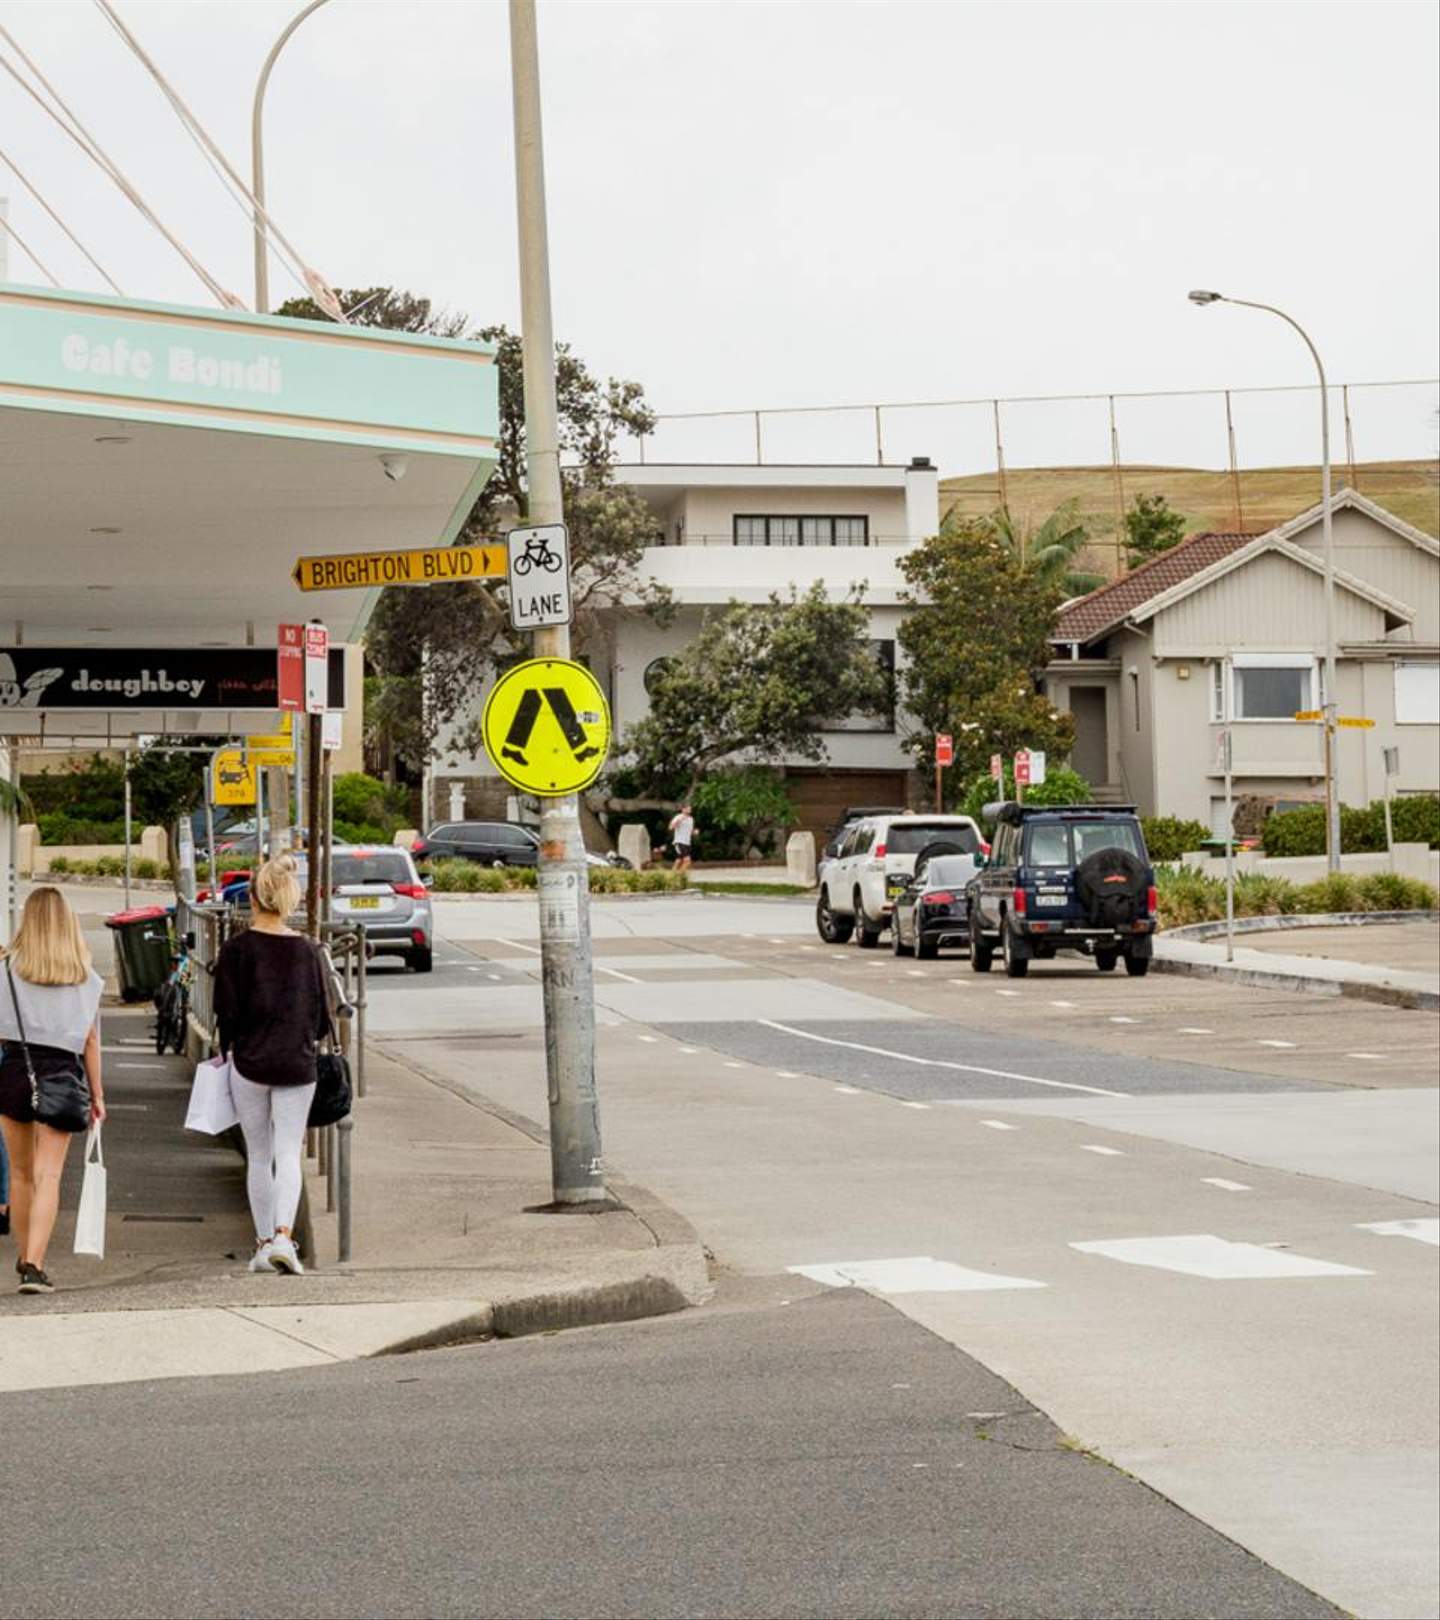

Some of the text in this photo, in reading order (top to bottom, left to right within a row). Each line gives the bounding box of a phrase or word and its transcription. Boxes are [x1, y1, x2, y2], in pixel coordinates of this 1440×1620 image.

[62, 333, 283, 395] Cafe Bondi
[311, 551, 474, 585] BRIGHTON BLVD
[518, 594, 564, 618] LANE
[71, 668, 206, 698] doughboy
